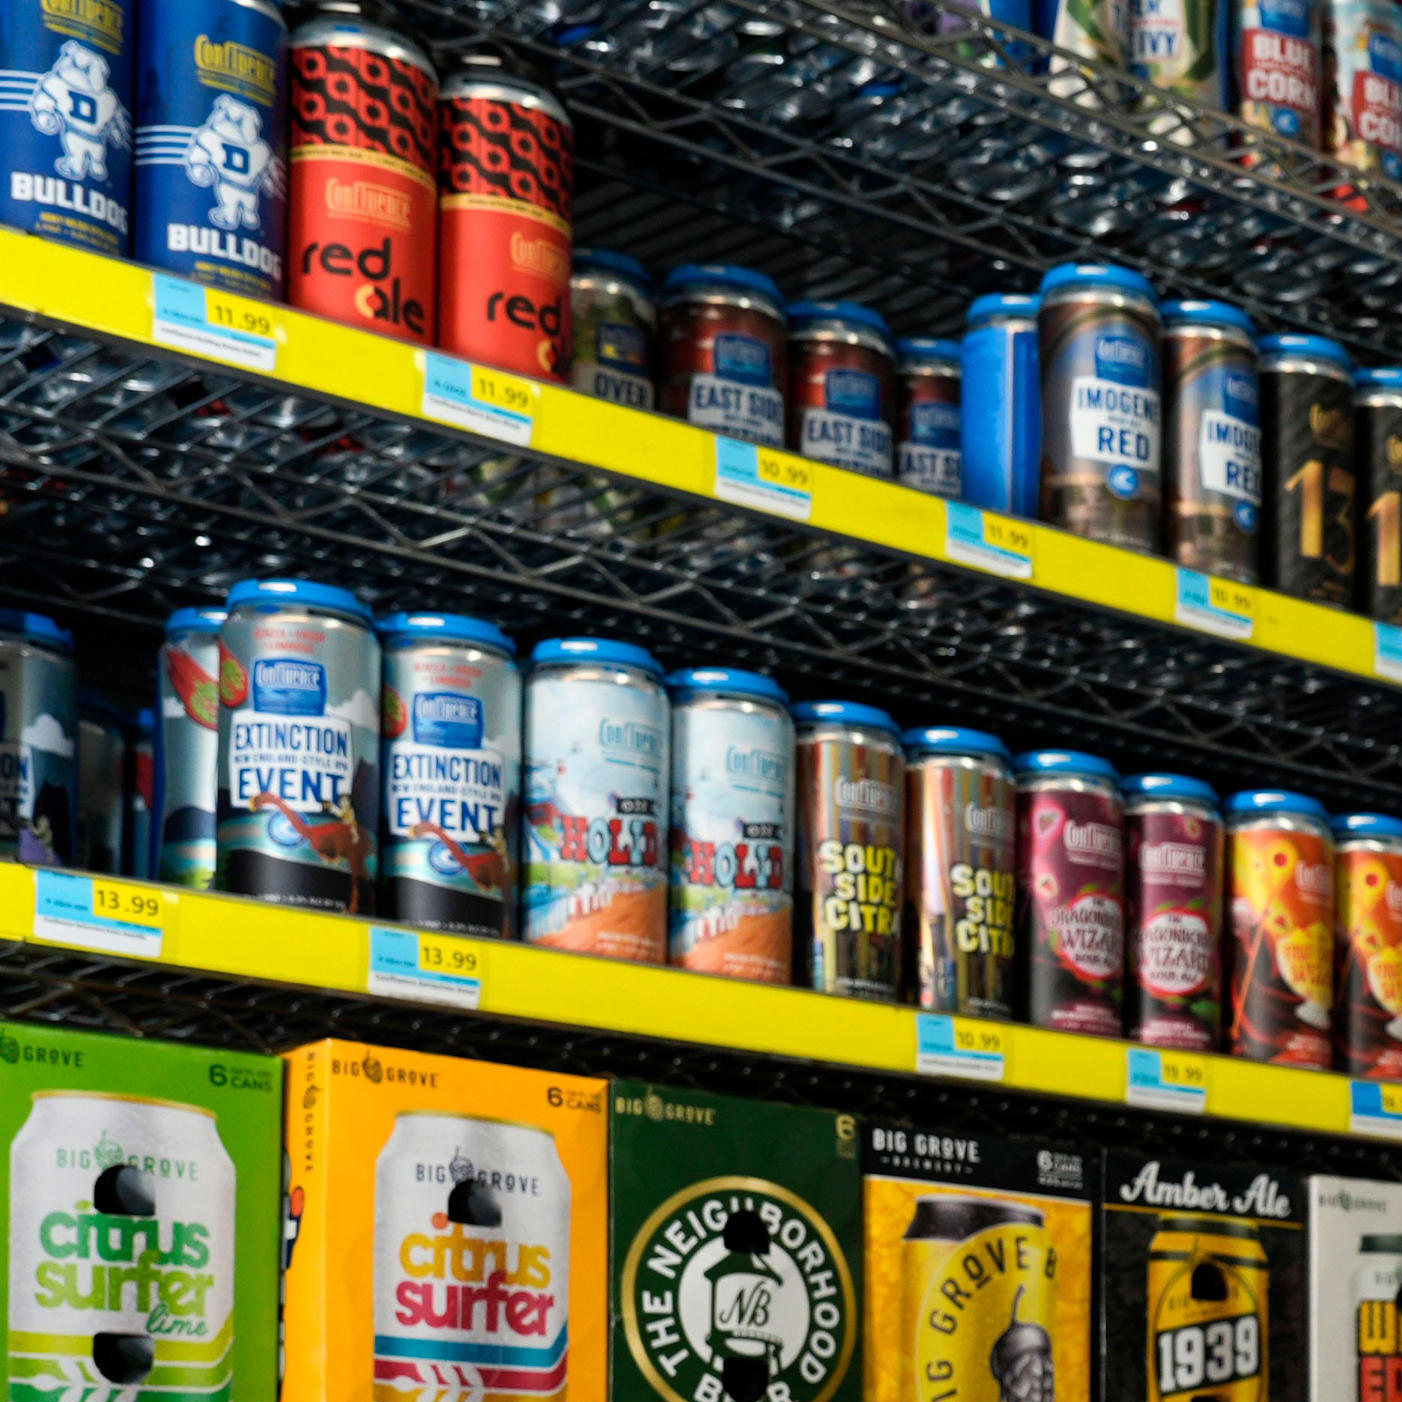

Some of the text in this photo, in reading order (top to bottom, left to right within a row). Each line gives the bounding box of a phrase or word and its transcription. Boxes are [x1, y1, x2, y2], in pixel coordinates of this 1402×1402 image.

[302, 237, 391, 276] red
[214, 305, 271, 335] 11.99
[355, 278, 425, 335] ale
[487, 290, 561, 336] red
[478, 378, 529, 409] 11.99
[695, 383, 747, 414] EAST
[807, 418, 848, 446] EAST
[1097, 426, 1150, 462] RED
[235, 721, 348, 757] EXTINCTION
[239, 772, 346, 806] EVENT
[395, 756, 500, 789] EXTINCTION
[398, 797, 499, 835] EVENT
[97, 889, 159, 917] 13.99
[423, 946, 477, 971] 13.99
[24, 1050, 84, 1068] GROVE
[208, 1064, 225, 1086] 6
[332, 1060, 440, 1089] BIG GROVE
[57, 1148, 90, 1169] BIG
[873, 1129, 979, 1163] BIG GROVE
[416, 1163, 446, 1184] BIG
[1121, 1162, 1230, 1207] Amber
[1234, 1173, 1290, 1218] Ale
[40, 1200, 210, 1268] citrus
[400, 1213, 551, 1289] citrus
[35, 1250, 214, 1317] surfer
[930, 1237, 1029, 1335] GROVE
[395, 1269, 554, 1337] surfer
[642, 1290, 690, 1377] THE
[1157, 1317, 1259, 1393] 1939
